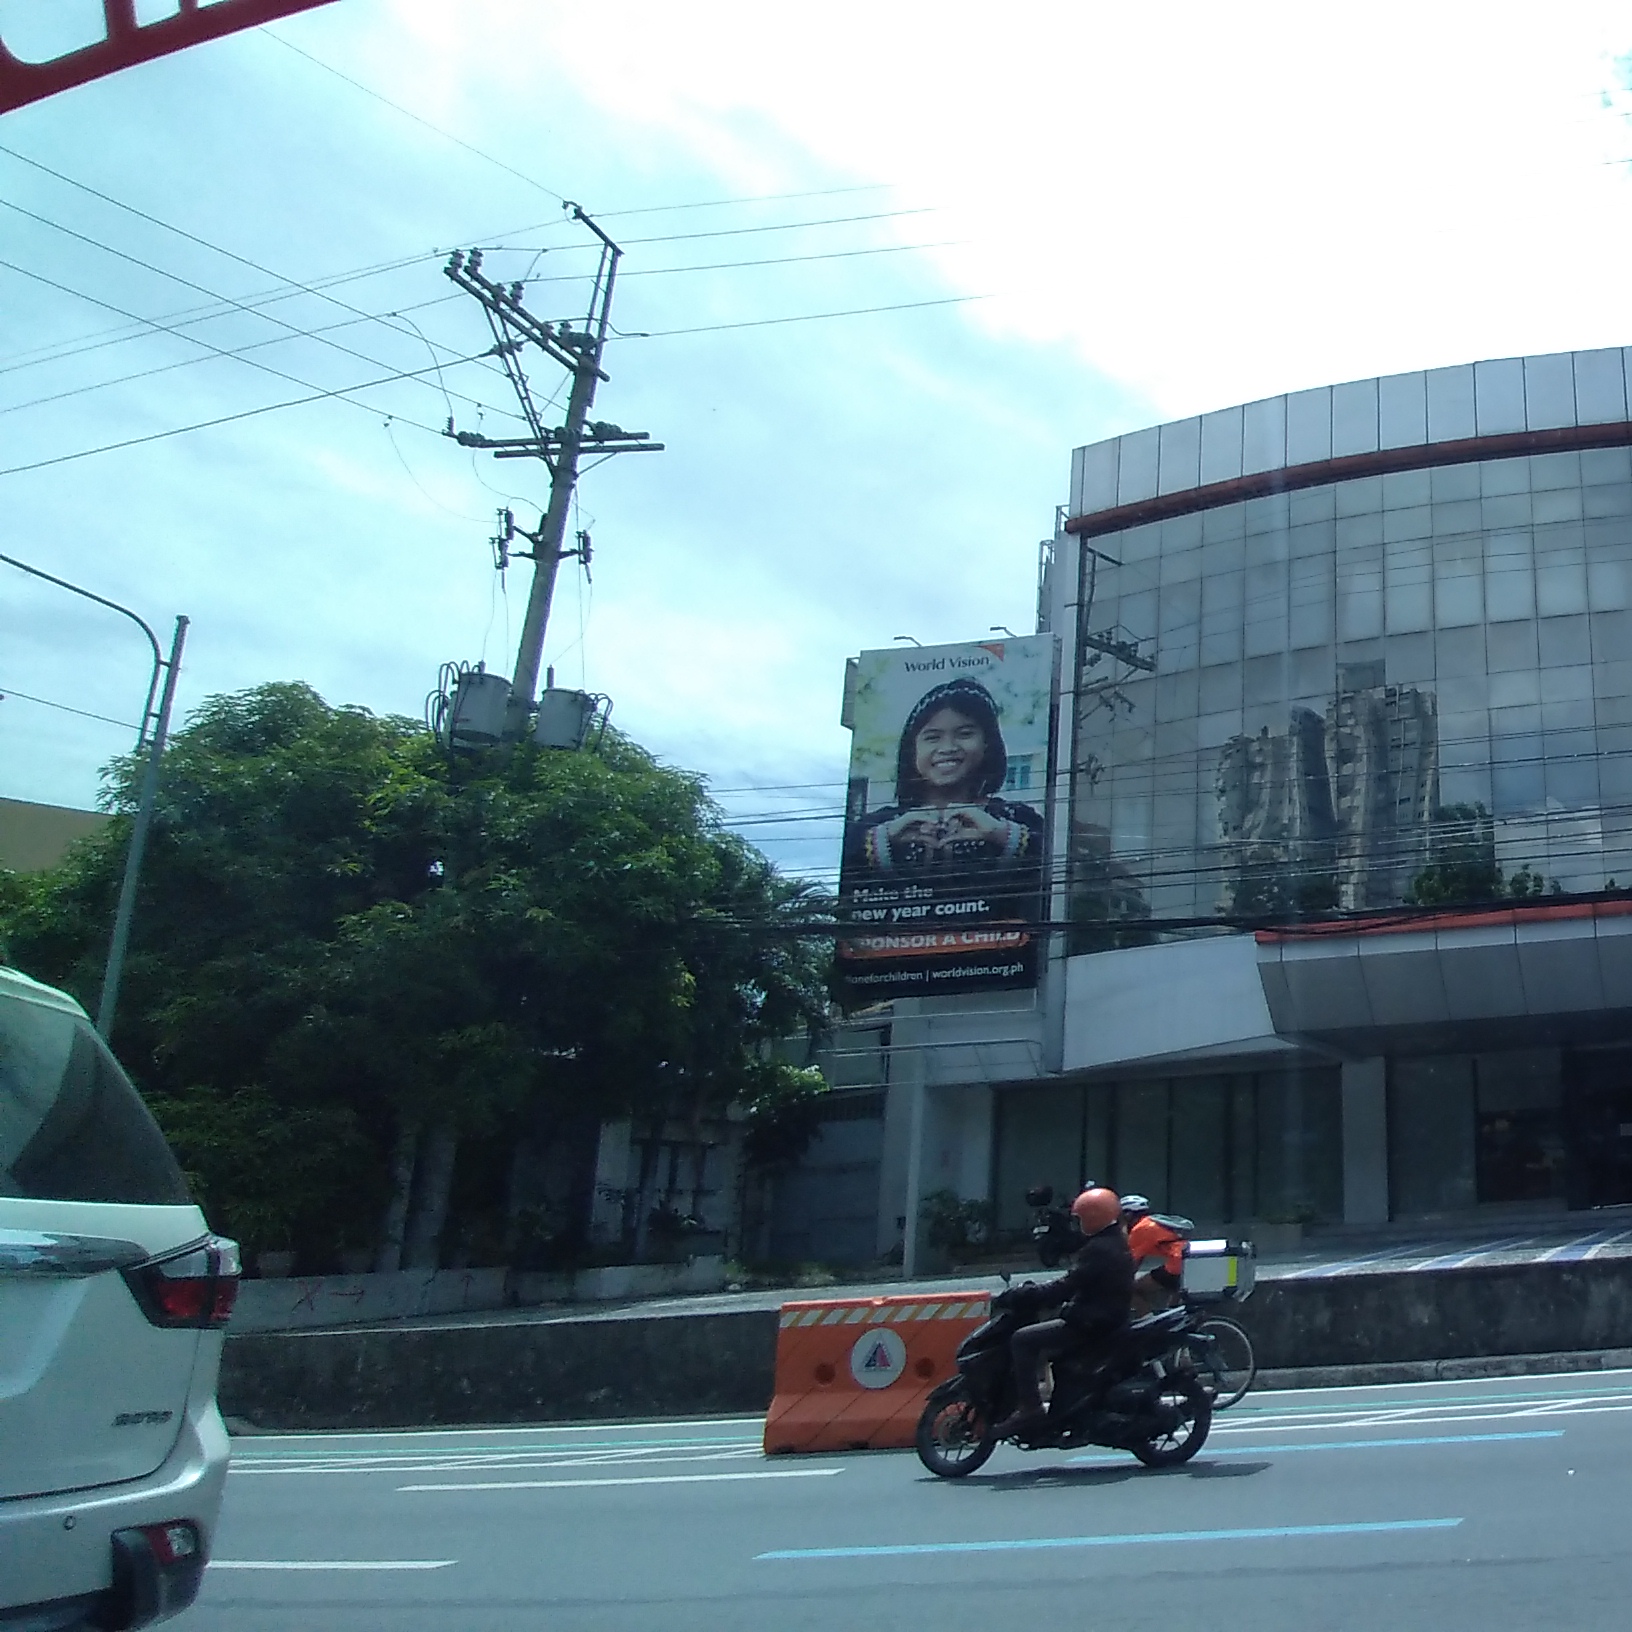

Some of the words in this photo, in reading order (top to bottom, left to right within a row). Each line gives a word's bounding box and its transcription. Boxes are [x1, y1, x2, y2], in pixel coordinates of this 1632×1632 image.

[904, 658, 945, 672] World
[949, 656, 989, 669] Vision
[904, 885, 933, 899] the
[852, 909, 887, 920] new
[892, 905, 931, 922] year
[935, 900, 990, 915] count.
[942, 934, 957, 946] A
[846, 971, 923, 984] oneforchildren
[932, 962, 1024, 978] worldvision.org.ph
